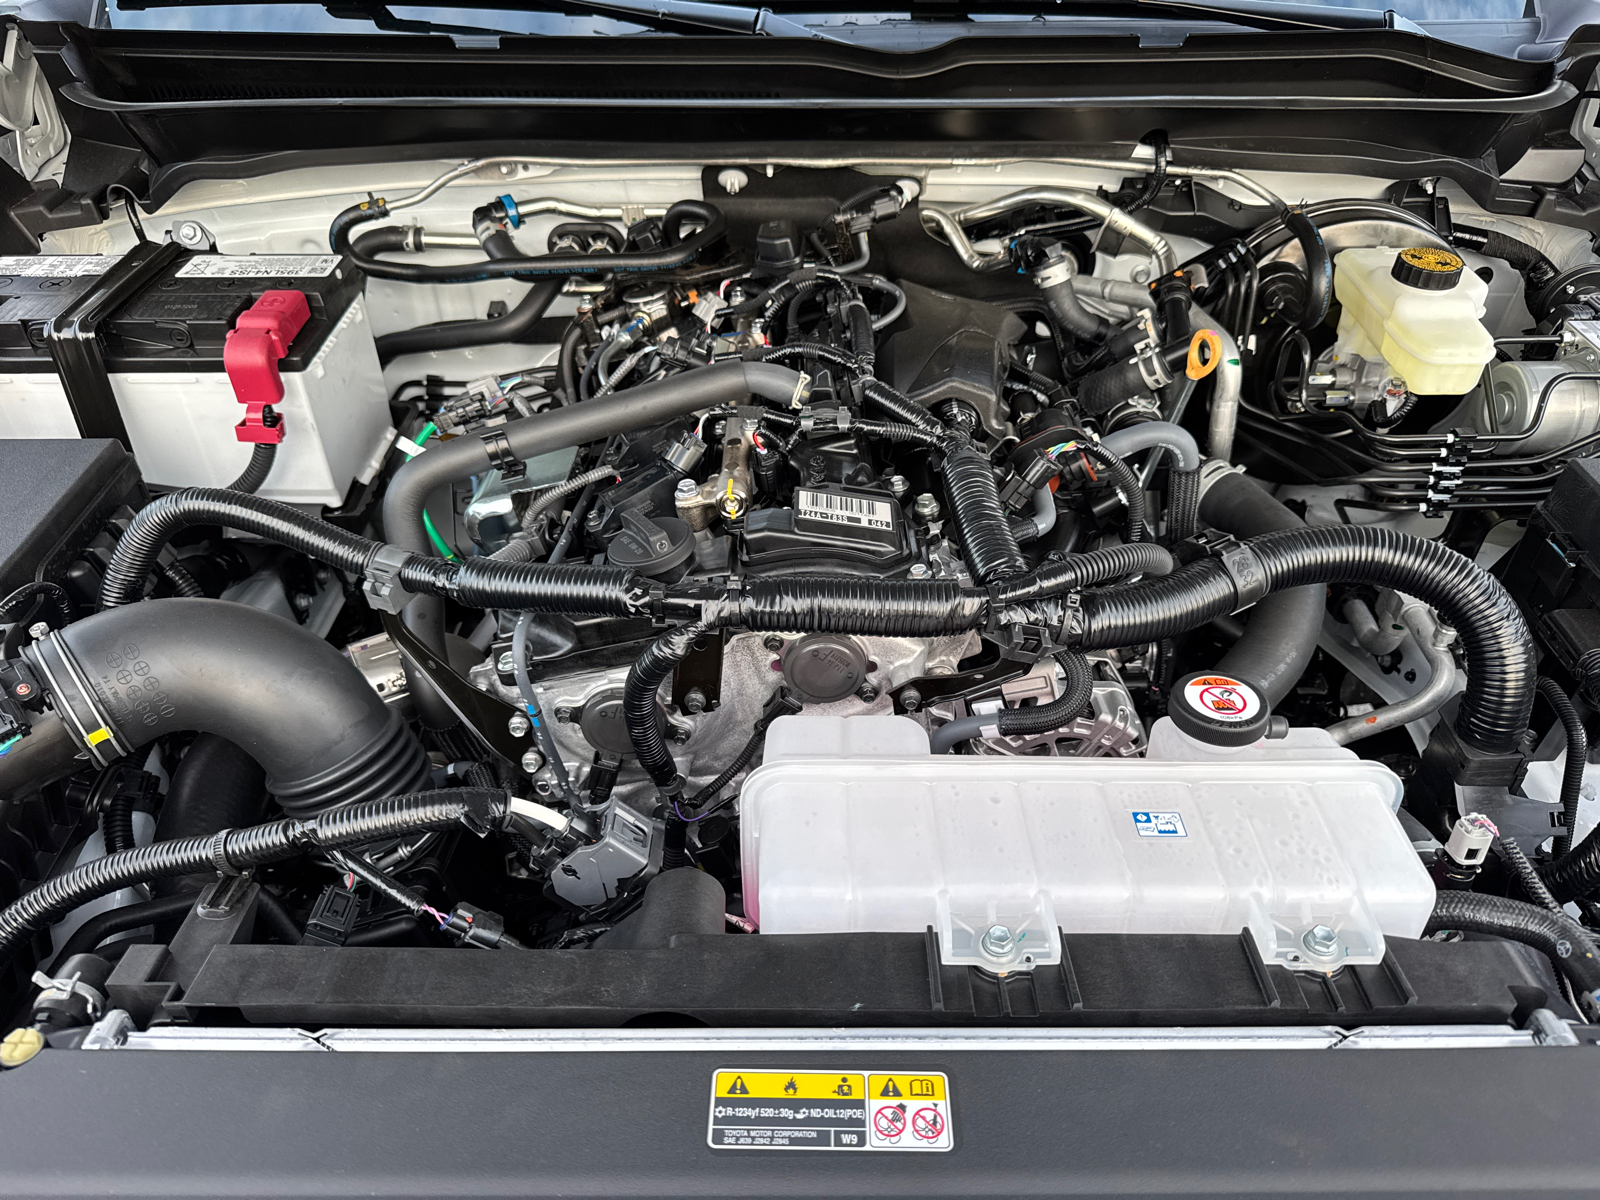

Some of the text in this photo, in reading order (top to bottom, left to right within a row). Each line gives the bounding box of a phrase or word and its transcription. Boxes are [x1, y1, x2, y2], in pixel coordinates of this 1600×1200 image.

[726, 1106, 865, 1120] R-1234yf 520±30g ND-OIL12(POE)
[724, 1129, 748, 1137] TOYOTA
[774, 1130, 817, 1138] CORPORATION
[841, 1134, 858, 1144] W9
